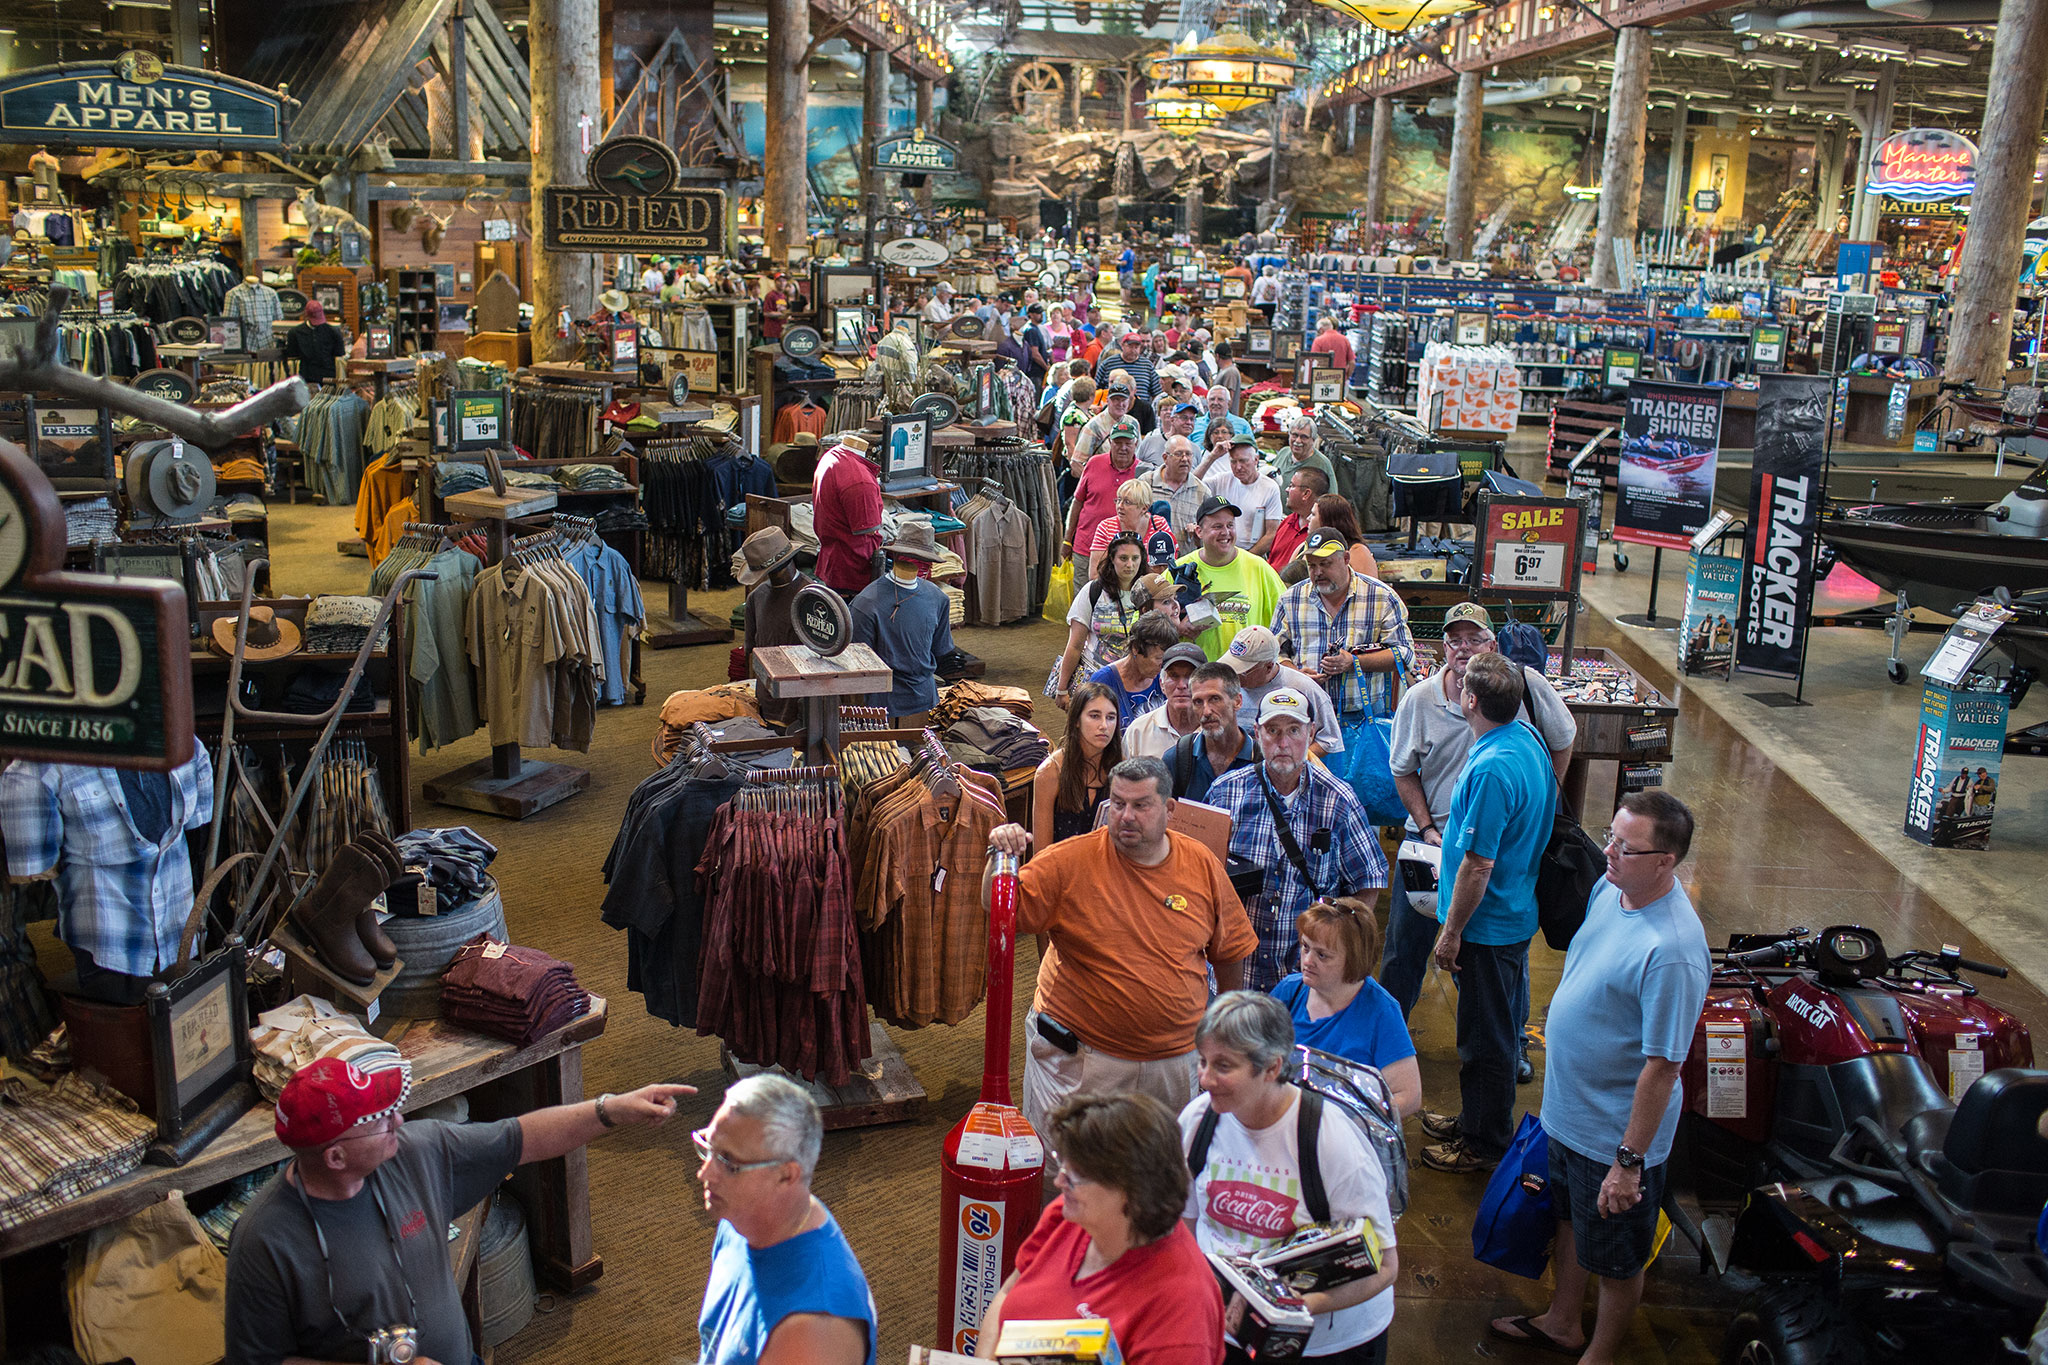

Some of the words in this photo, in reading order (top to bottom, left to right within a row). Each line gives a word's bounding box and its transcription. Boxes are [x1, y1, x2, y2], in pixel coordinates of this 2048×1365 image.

[77, 80, 212, 110] MEN'S
[45, 103, 242, 133] APPAREL
[889, 152, 945, 167] APPAREL
[1884, 144, 1970, 165] Marine
[1884, 160, 1961, 182] Center
[555, 194, 712, 233] REDHEAD
[618, 330, 633, 339] SALE
[1646, 392, 1668, 400] WHEN
[1669, 394, 1697, 402] OTHERS
[1630, 398, 1718, 423] TRACKER
[44, 426, 92, 434] TREK
[1649, 417, 1716, 439] SHINES.
[1573, 476, 1601, 484] TRACKER
[1626, 486, 1651, 494] INDUSTRY
[1651, 489, 1679, 498] EXCLUSIVE
[1501, 508, 1564, 530] SALE
[1309, 534, 1322, 547] 9
[126, 559, 141, 569] RED
[142, 559, 162, 569] HEAD
[1761, 475, 1809, 650] TRACKER
[1702, 572, 1735, 582] VALUES
[1697, 589, 1735, 600] TRACKER
[1747, 564, 1767, 646] boats
[806, 613, 834, 636] REDHEAD
[1678, 583, 1694, 661] TRACKER
[1354, 659, 1363, 677] IKEA
[1361, 687, 1369, 706] IKEA
[1954, 701, 1974, 711] GREAT
[3, 713, 63, 737] SINCE
[68, 719, 114, 742] 1856
[1956, 713, 2000, 725] VALUES
[1950, 738, 1999, 748] TRACKER
[1914, 727, 1942, 832] TRACKER
[1907, 777, 1920, 825] boats
[1785, 993, 1813, 1018] ARCTIC
[1809, 1009, 1831, 1029] CAT
[1221, 1158, 1242, 1166] LAS
[1247, 1164, 1289, 1175] VEGAS
[1234, 1190, 1258, 1201] DRINK
[970, 1206, 992, 1236] 76
[1213, 1191, 1289, 1230] Coca-Cola
[984, 1244, 996, 1296] OFFICIAL
[960, 1270, 978, 1328] NASCAR
[1884, 1287, 1930, 1299] XT
